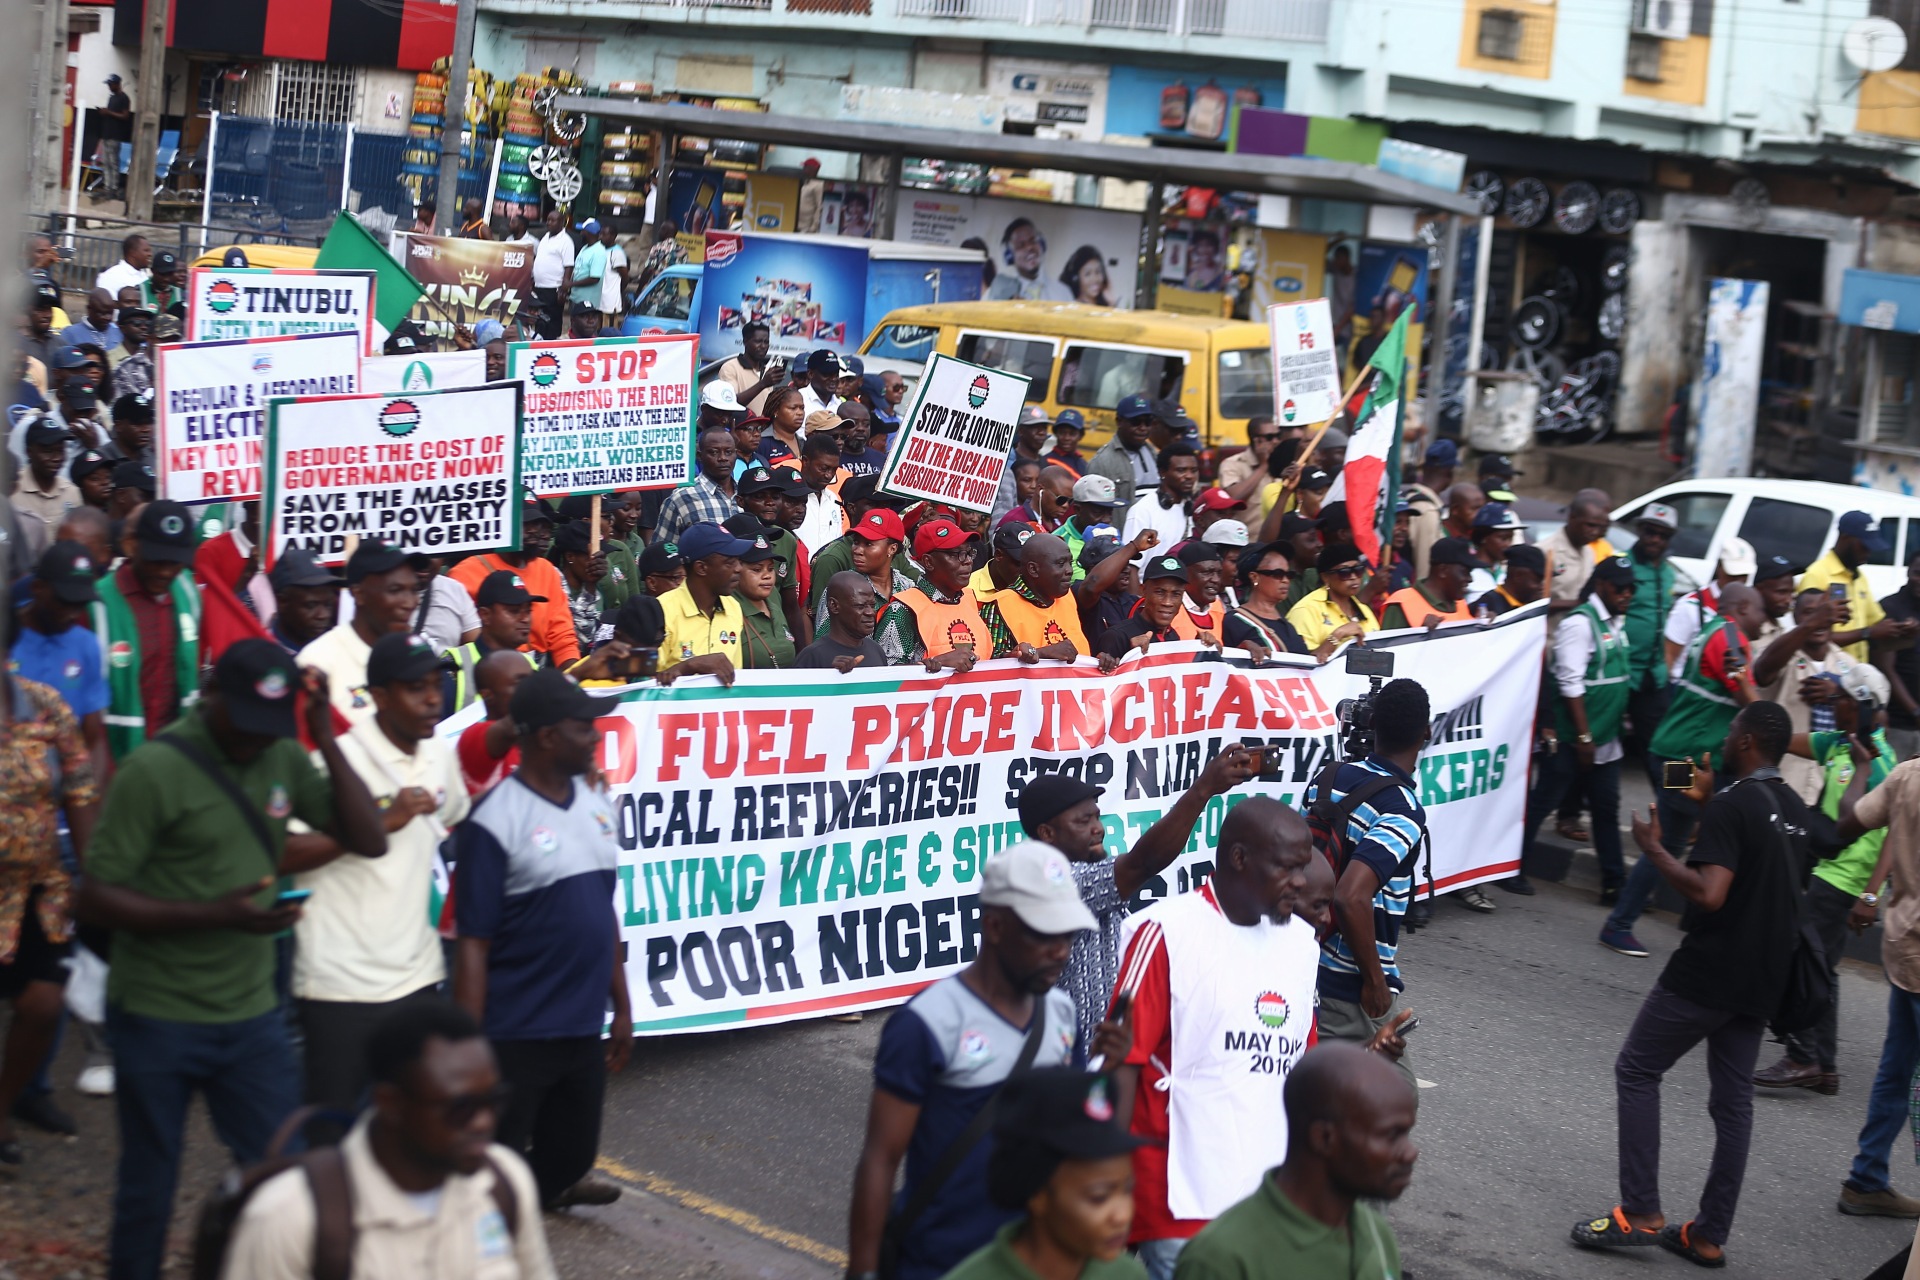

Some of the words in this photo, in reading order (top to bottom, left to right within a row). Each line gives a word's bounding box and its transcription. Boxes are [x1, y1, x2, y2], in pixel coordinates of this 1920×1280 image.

[244, 287, 358, 316] TINUBU,
[576, 349, 657, 384] STOP
[169, 385, 238, 414] REGULAR
[246, 384, 254, 407] &
[263, 375, 354, 395] AFFORDABLE
[617, 386, 646, 409] THE
[650, 384, 688, 406] RICH!
[186, 410, 263, 442] ELECTR
[538, 415, 559, 433] TIME
[563, 413, 573, 431] TO
[577, 412, 600, 430] TASK
[602, 411, 621, 428] AND
[624, 409, 642, 427] TAX
[645, 408, 662, 425] THE
[664, 407, 686, 423] RICH!
[916, 402, 949, 436] STOP
[944, 409, 971, 442] THE
[965, 415, 1014, 454] LOOTING!
[285, 444, 367, 468] REDUCE
[375, 443, 413, 463] THE
[420, 438, 475, 459] COST
[481, 435, 505, 454] OF
[522, 437, 539, 453] AY
[543, 434, 578, 452] LIVING
[582, 431, 614, 449] WAGE
[616, 429, 638, 447] AND
[642, 427, 687, 445] SUPPORT
[170, 447, 209, 472] KEY
[215, 443, 238, 467] TO
[285, 462, 436, 489] GOVERNANCE
[443, 455, 504, 479] NOW!
[522, 451, 602, 472] NFORMAL
[607, 445, 684, 467] WORKERS
[906, 436, 933, 464] TAX
[928, 442, 953, 469] THE
[950, 449, 980, 476] RICH
[976, 455, 1004, 481] AND
[203, 467, 262, 497] REVI
[523, 474, 537, 491] ET
[541, 471, 568, 490] POOR
[573, 468, 632, 487] NIGERIANS
[636, 464, 685, 482] BREATHE
[893, 462, 948, 492] SUBSIDIZE
[943, 472, 965, 500] THE
[961, 478, 997, 507] POOR!!
[283, 492, 347, 514] SAVE
[358, 489, 402, 509] THE
[412, 479, 507, 506] MASSES
[282, 512, 366, 535] FROM
[380, 499, 507, 527] POVERTY
[284, 534, 344, 555] AND
[360, 519, 501, 548] NGER!!
[594, 715, 637, 784] O
[657, 709, 827, 782] FUEL
[846, 691, 1021, 771] PRICE
[1031, 672, 1336, 752] INCREASE!
[615, 789, 720, 851] OCAL
[731, 763, 981, 842] REFINERIES!!
[617, 854, 766, 927] LIVING
[779, 834, 908, 907] WAGE
[918, 831, 942, 888] &
[1411, 743, 1509, 807] KERS
[646, 920, 804, 1007] POOR
[818, 893, 982, 986] NIGER
[1225, 1030, 1272, 1052] MAY
[1249, 1054, 1292, 1076] 2016
